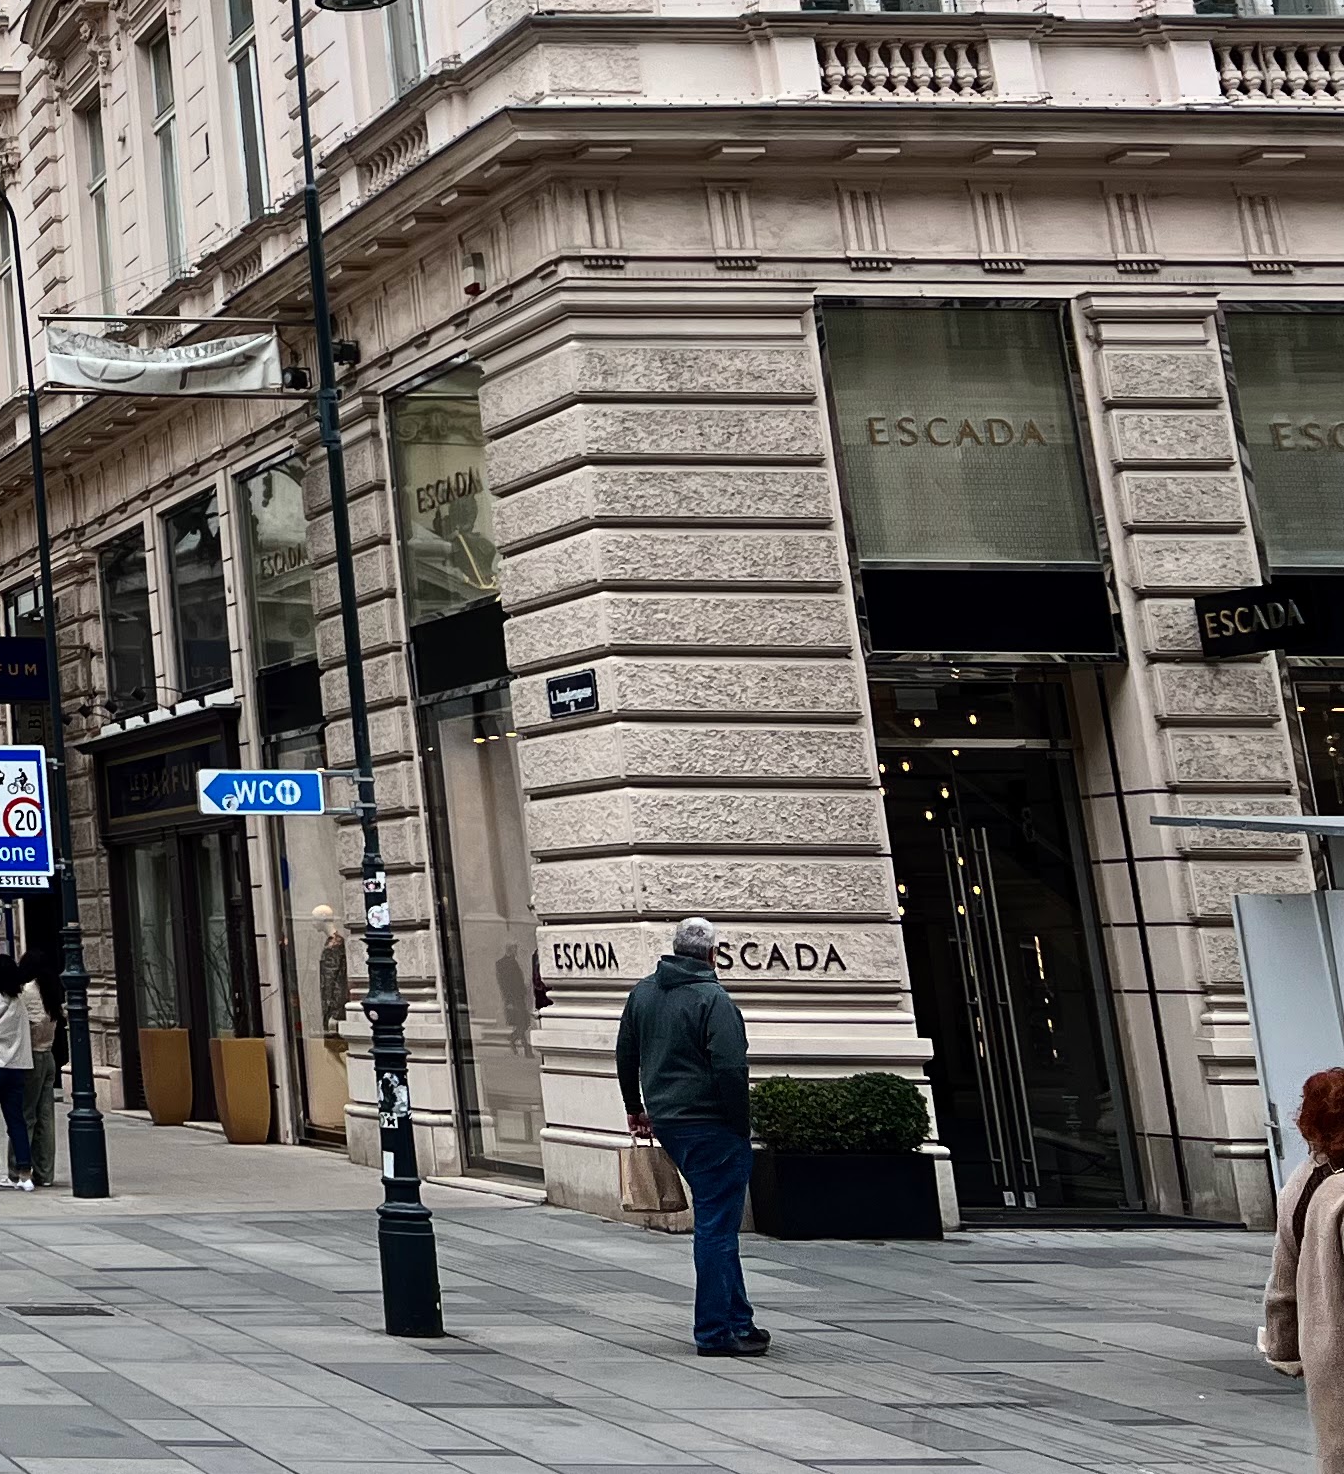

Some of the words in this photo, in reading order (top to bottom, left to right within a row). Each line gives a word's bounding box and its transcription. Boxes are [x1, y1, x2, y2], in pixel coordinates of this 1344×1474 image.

[867, 417, 1047, 446] ESCADA
[417, 466, 478, 513] ESCADA
[1205, 599, 1306, 640] ESCADA
[233, 779, 274, 804] WC
[14, 809, 37, 831] 20
[553, 942, 619, 971] ESCADA
[716, 942, 847, 972] SCADA
